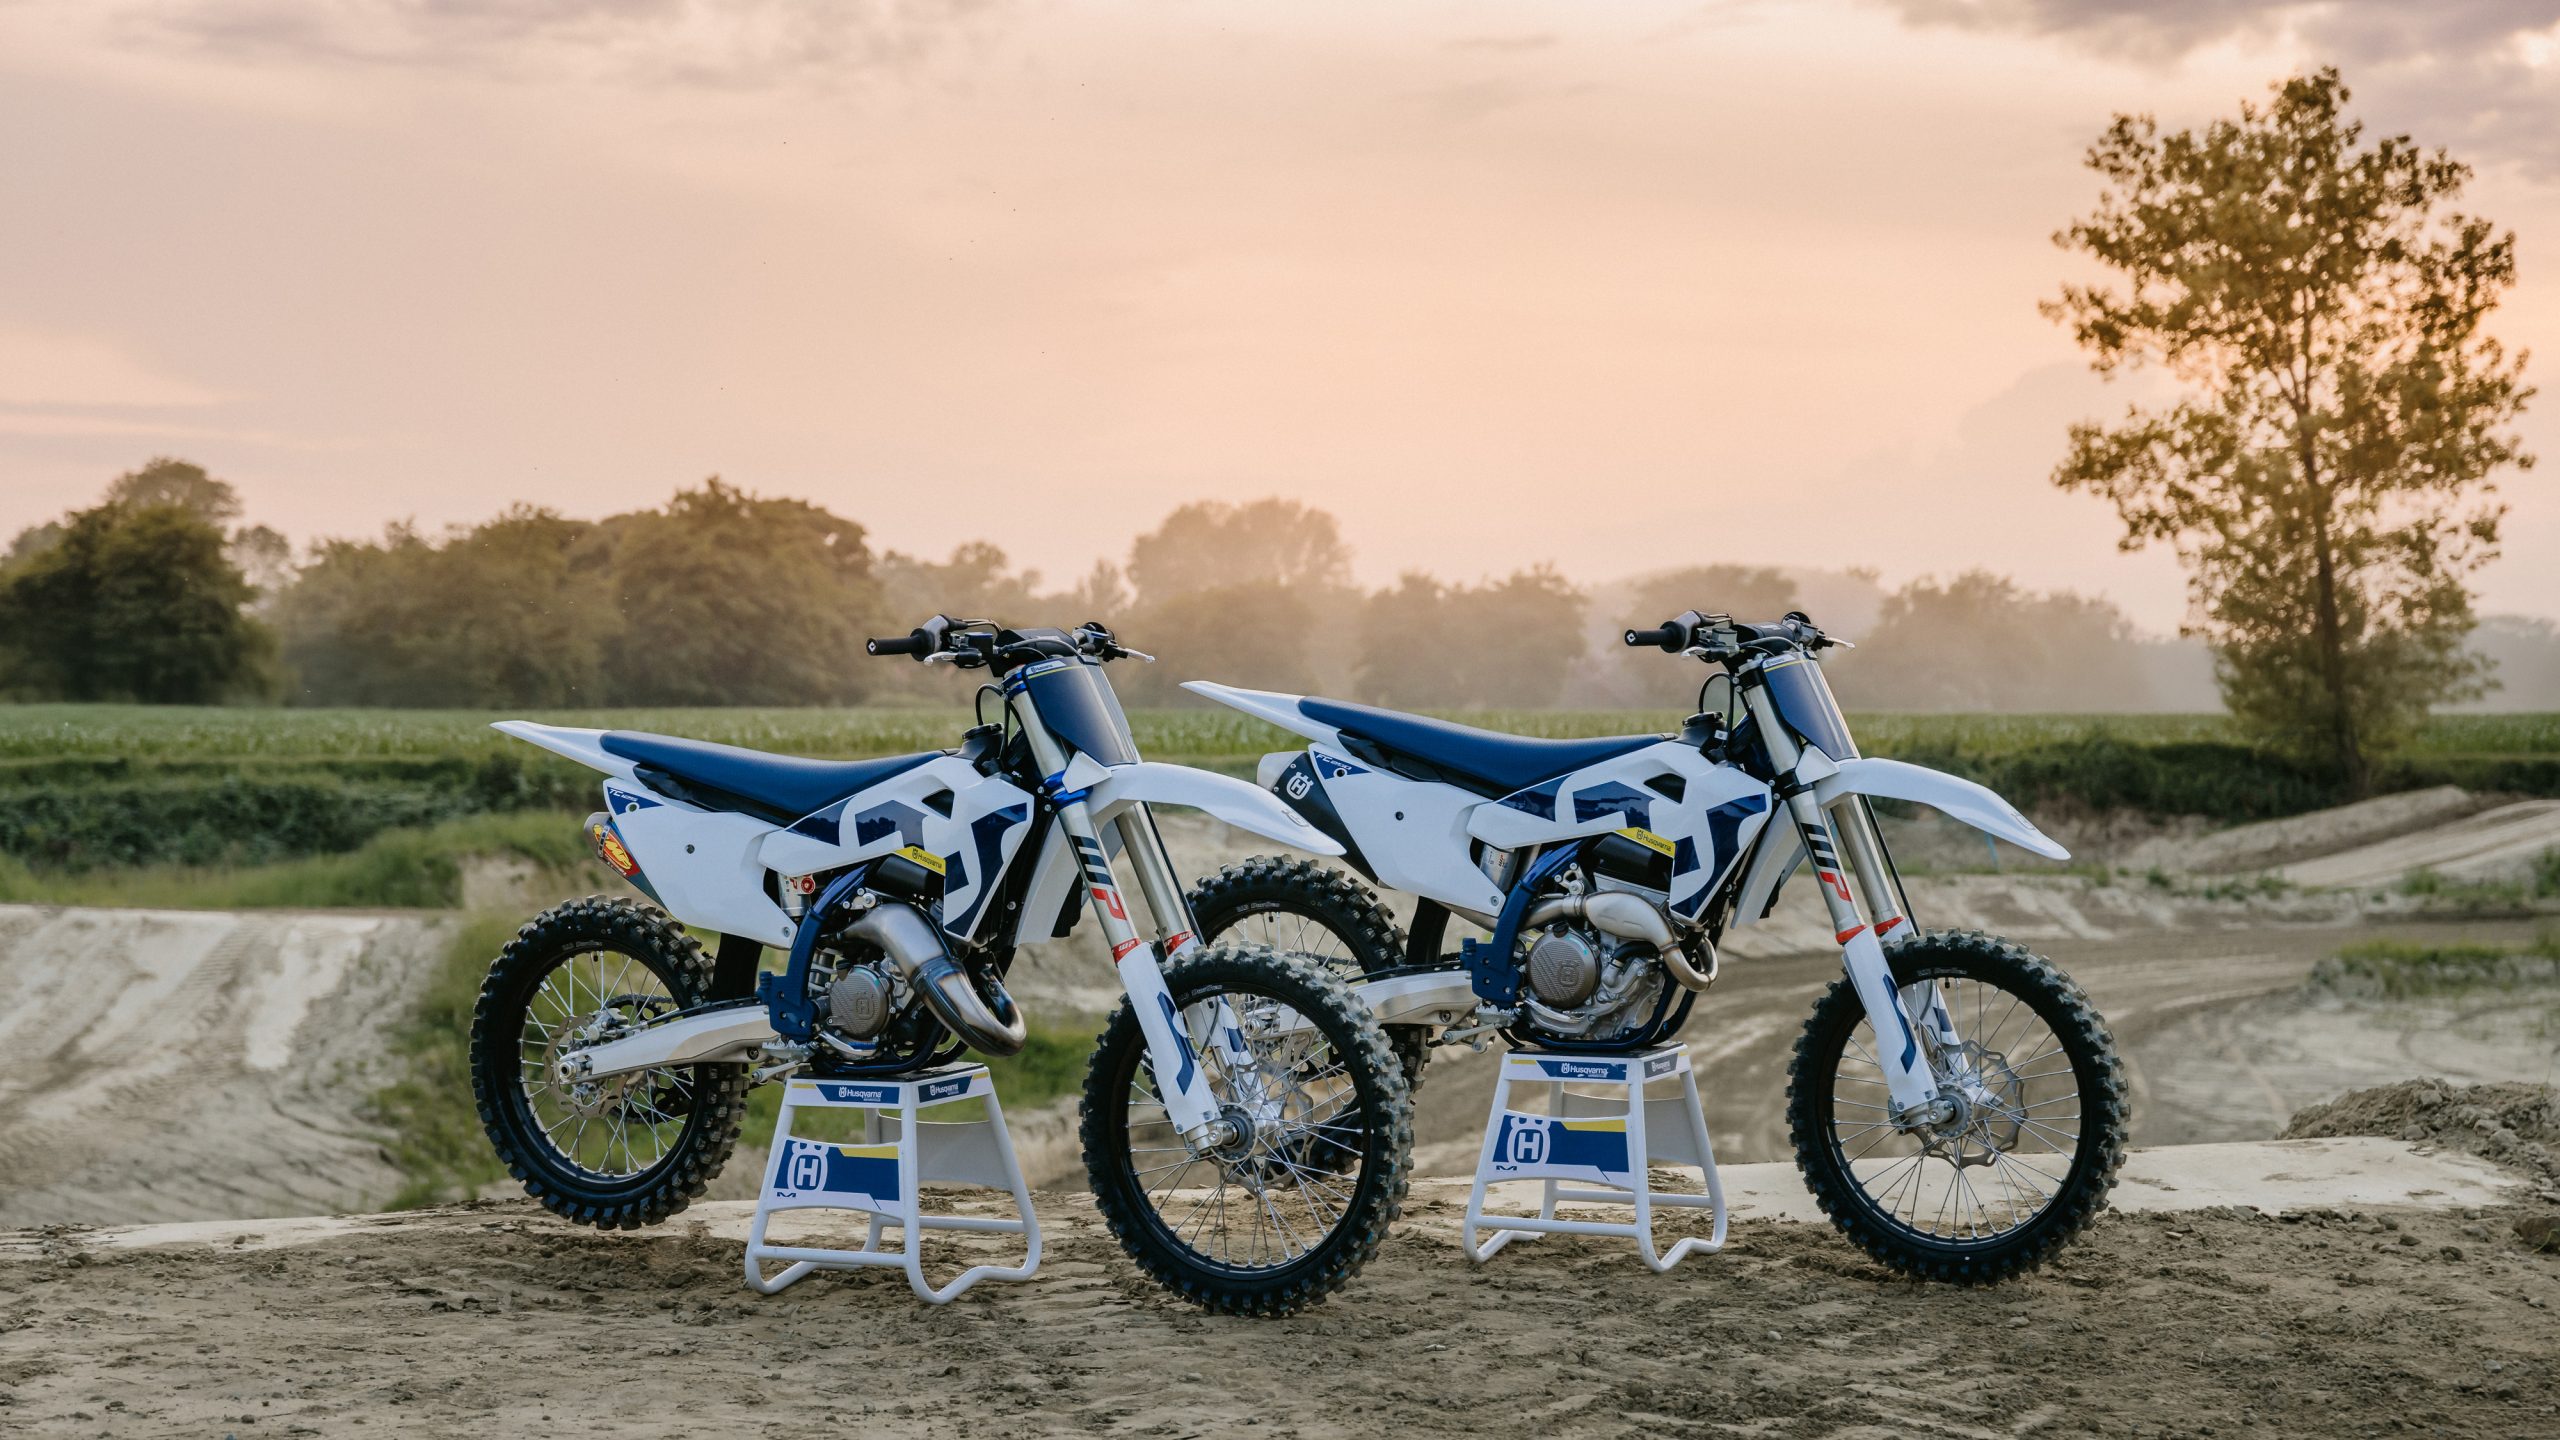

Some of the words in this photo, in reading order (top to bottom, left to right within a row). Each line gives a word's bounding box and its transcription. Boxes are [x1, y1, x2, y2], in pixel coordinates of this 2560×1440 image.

[609, 788, 624, 797] TC
[1570, 1064, 1607, 1075] Husqvarna
[847, 1089, 881, 1099] Husqvarna
